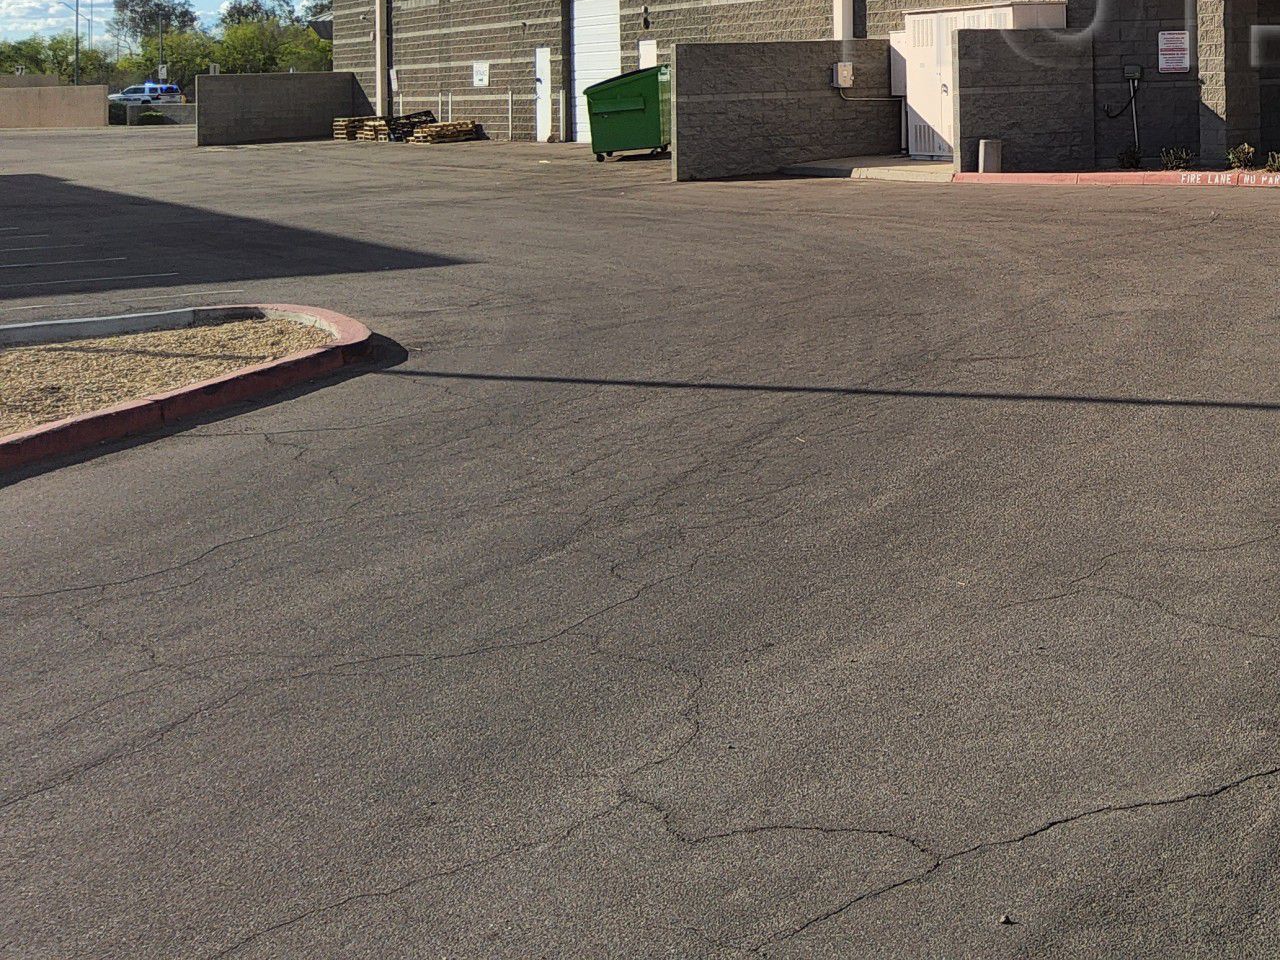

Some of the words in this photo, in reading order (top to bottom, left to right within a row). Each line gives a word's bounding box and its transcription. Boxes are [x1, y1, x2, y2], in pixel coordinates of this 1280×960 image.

[1180, 173, 1201, 185] FIRE
[1207, 173, 1232, 185] LANE
[1243, 174, 1256, 185] NO
